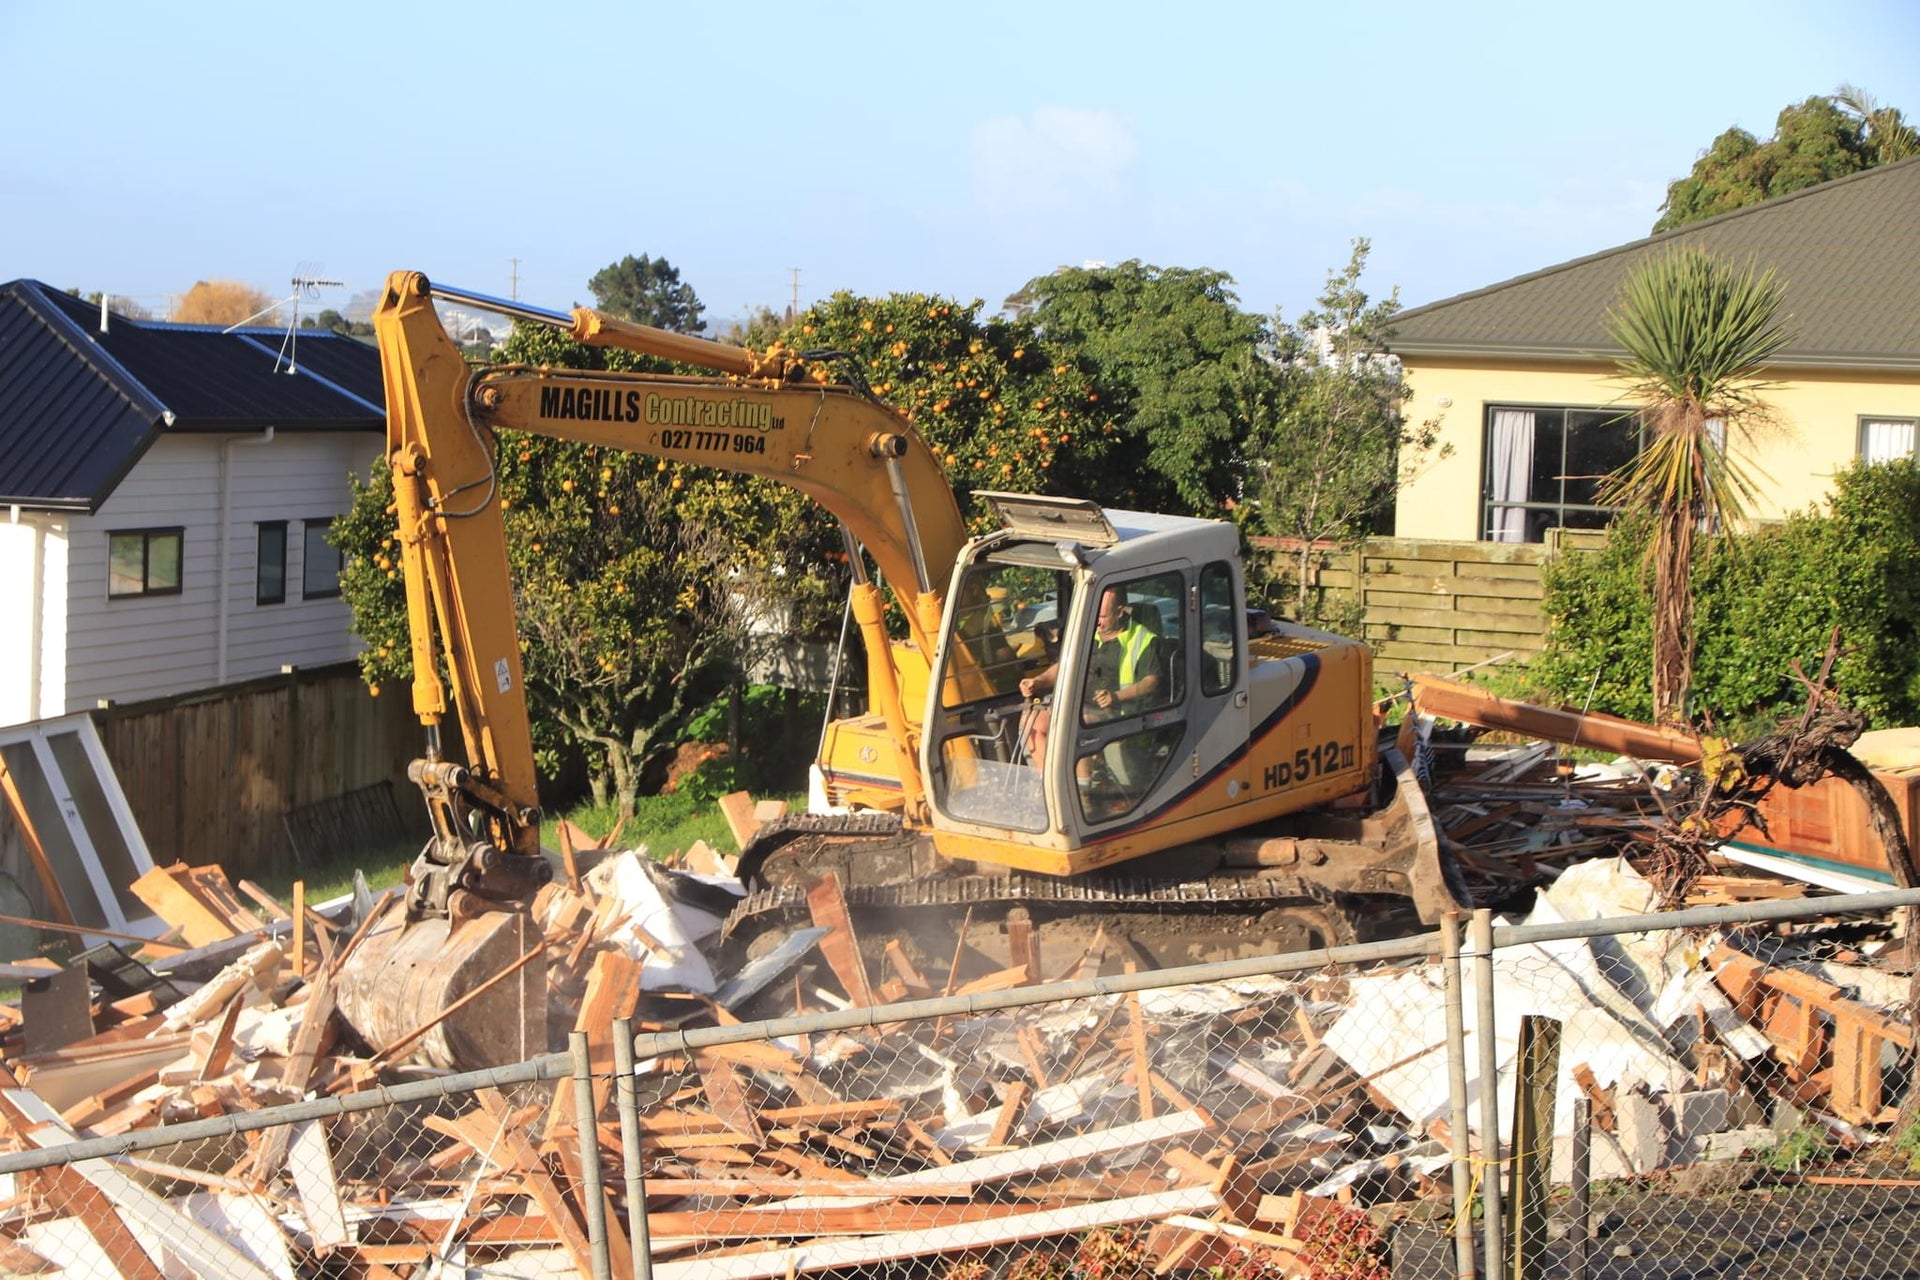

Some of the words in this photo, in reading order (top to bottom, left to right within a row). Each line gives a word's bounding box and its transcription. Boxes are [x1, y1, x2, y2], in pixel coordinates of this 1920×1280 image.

[540, 386, 640, 422] MAGILLS
[645, 392, 773, 432] Contracting
[772, 416, 785, 429] Ltd
[661, 430, 691, 449] 027
[695, 431, 730, 452] 7777
[733, 435, 766, 454] 964
